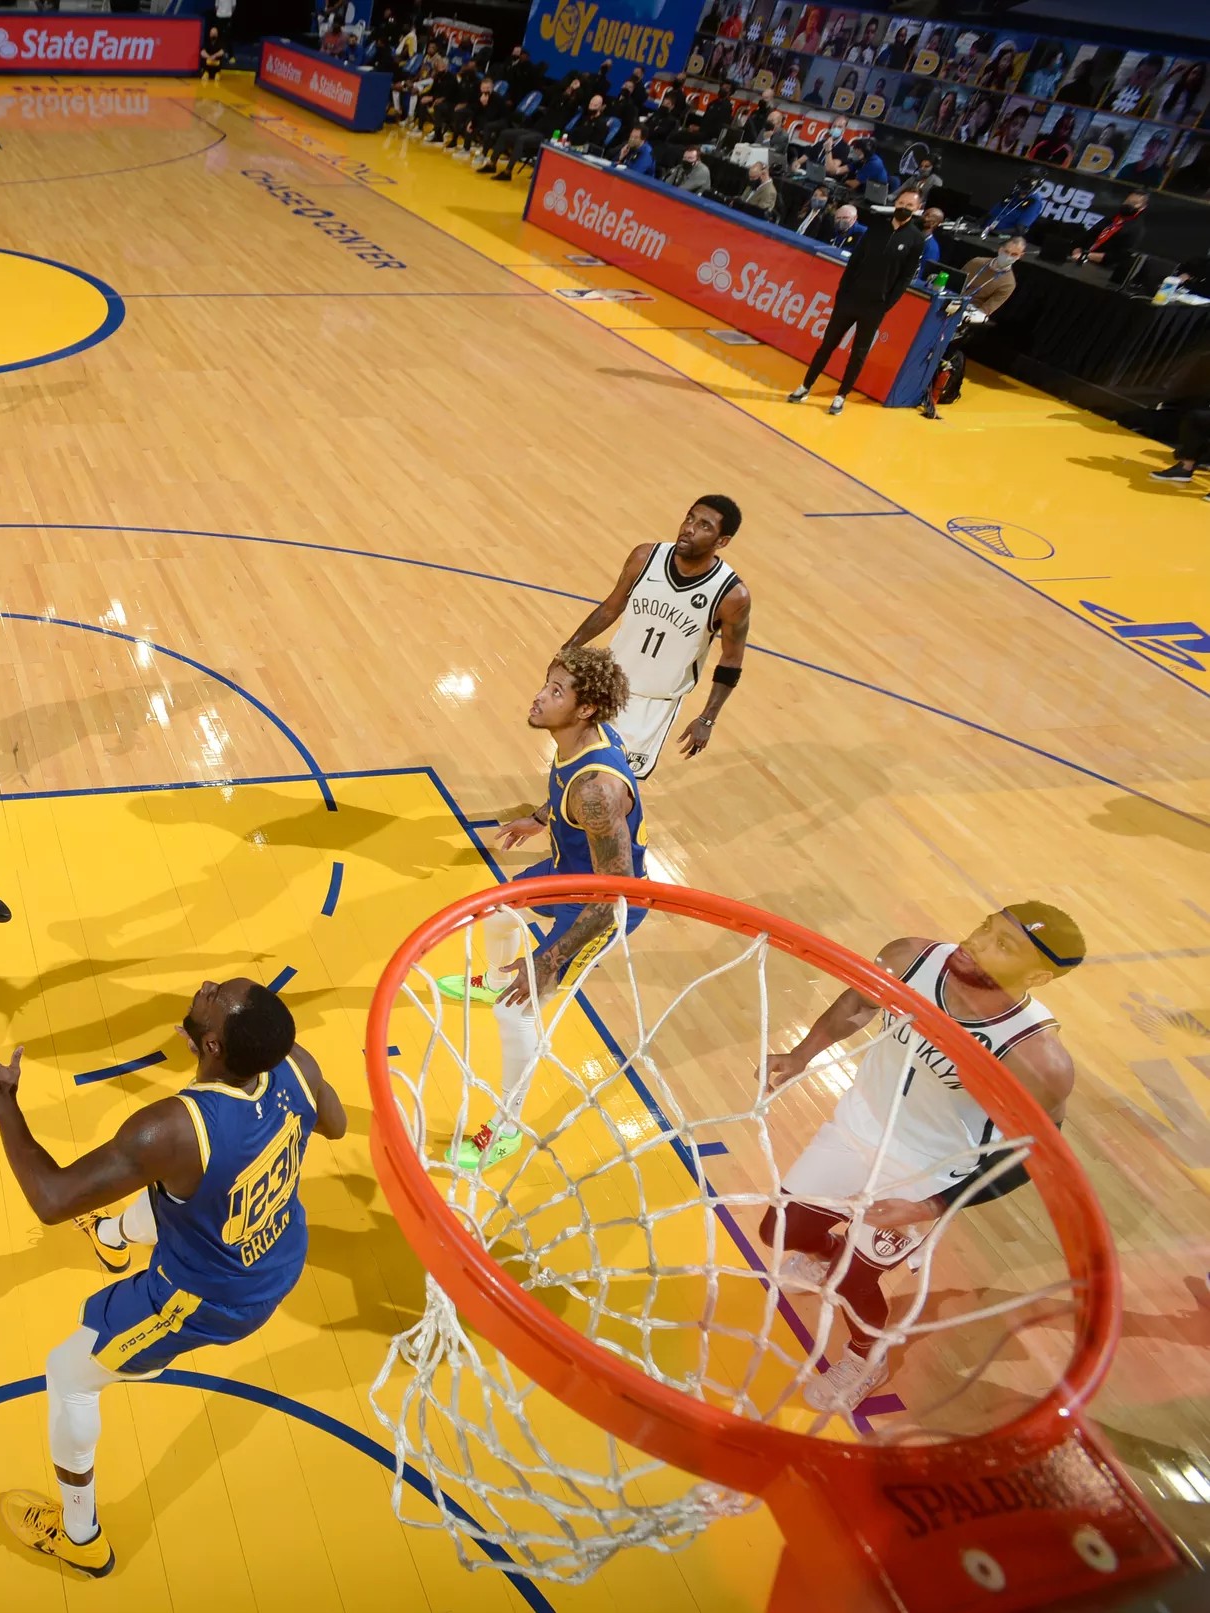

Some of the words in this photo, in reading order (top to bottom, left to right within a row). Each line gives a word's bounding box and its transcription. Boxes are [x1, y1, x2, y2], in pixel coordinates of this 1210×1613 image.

[241, 169, 315, 206] CHASE
[313, 221, 407, 269] CENTER
[632, 597, 701, 637] BROOKLYN
[640, 626, 666, 659] 11
[247, 1146, 289, 1229] 23
[240, 1210, 290, 1268] GREEN
[118, 1304, 185, 1353] WARRIORS
